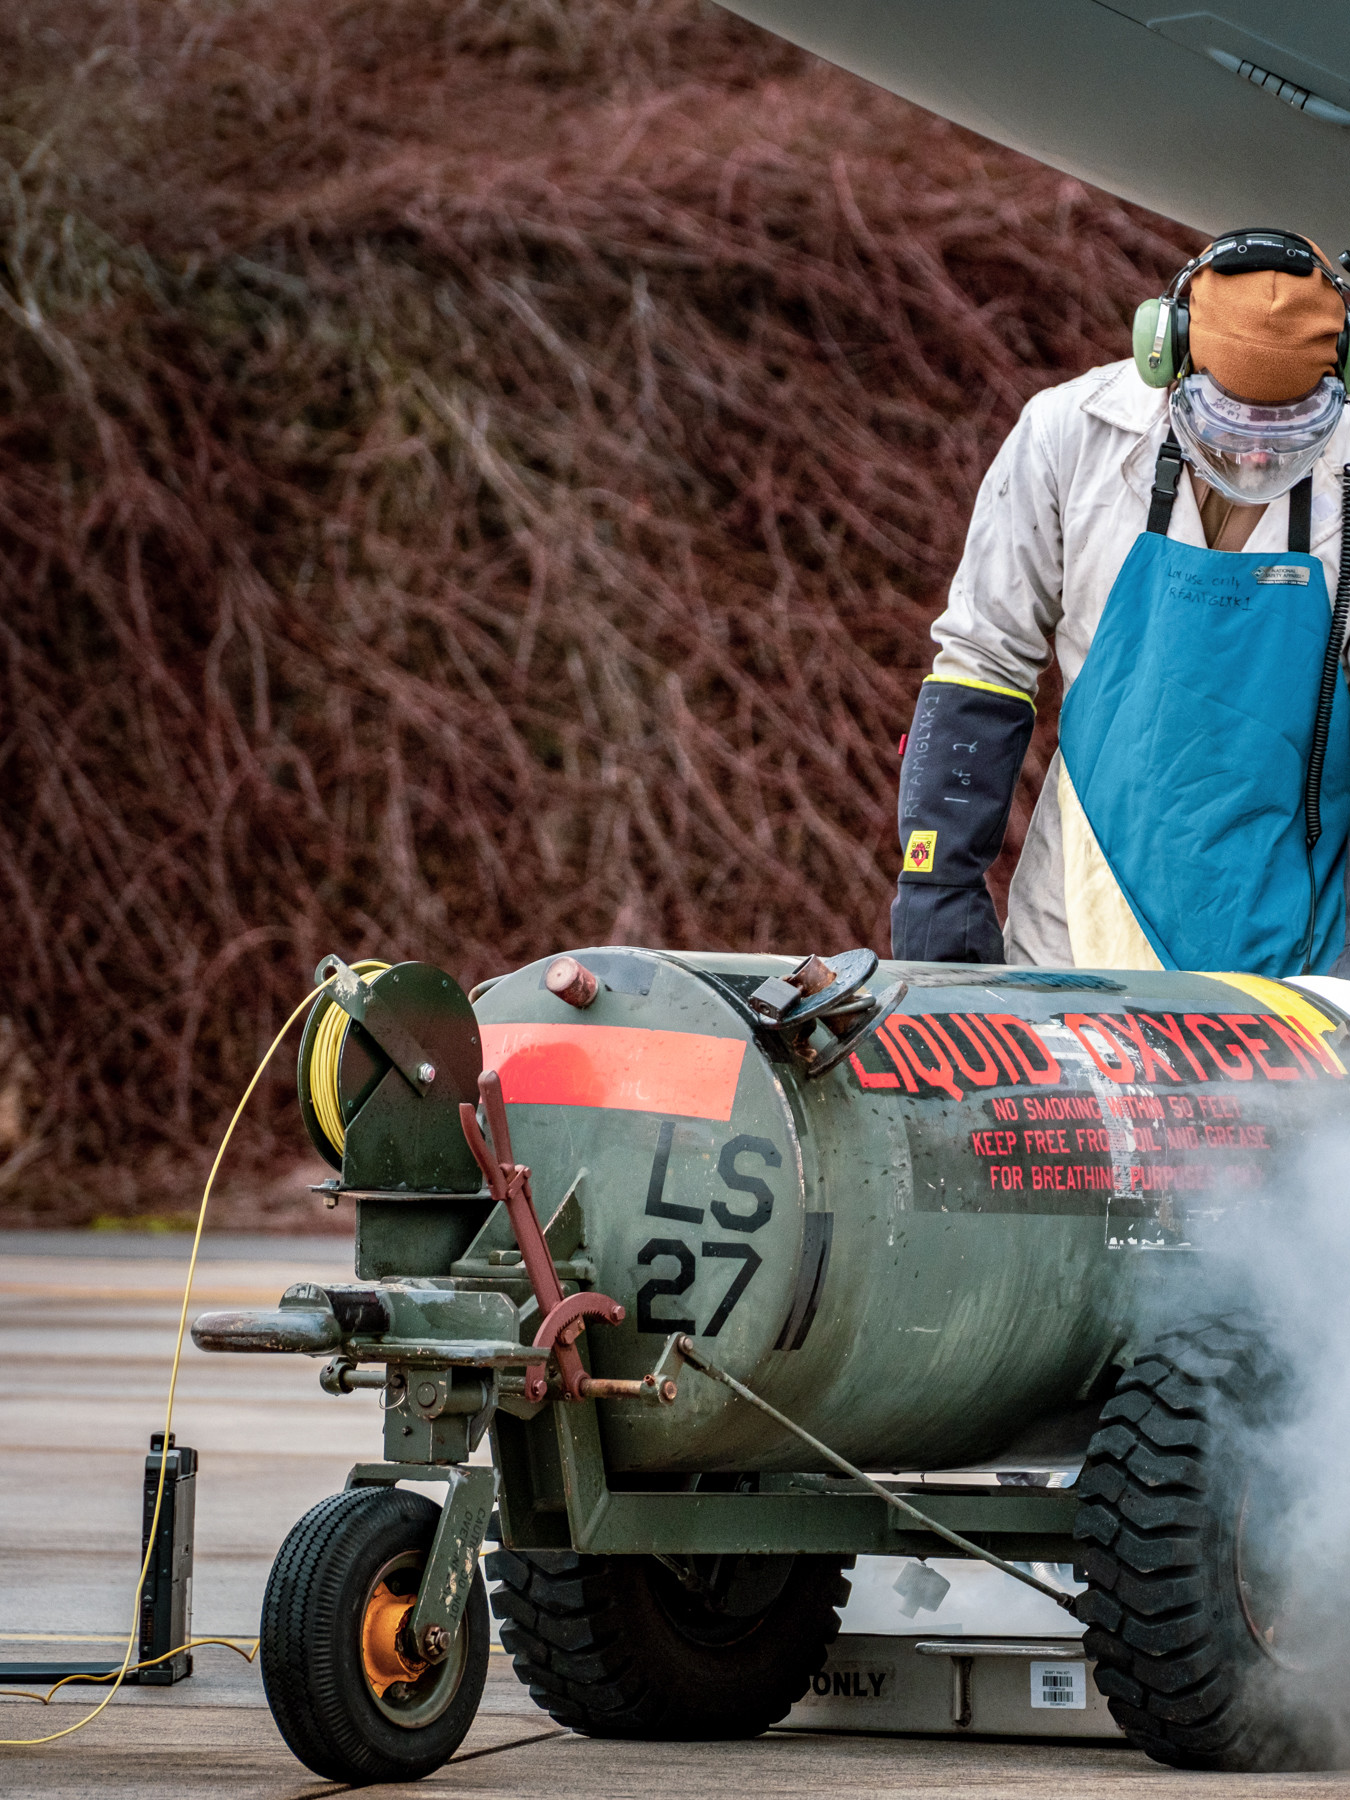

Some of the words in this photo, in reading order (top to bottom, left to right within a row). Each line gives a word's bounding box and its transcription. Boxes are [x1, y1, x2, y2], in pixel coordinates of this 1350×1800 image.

[904, 693, 941, 818] RFAMGLXK1
[849, 1013, 1062, 1103] LIQUID
[1064, 1013, 1348, 1084] OXYGEN
[992, 1098, 1018, 1121] NO
[1023, 1097, 1102, 1121] SMOKING
[1168, 1095, 1194, 1118] 50
[1197, 1095, 1243, 1118] FEET
[972, 1131, 1017, 1156] KEEP
[1024, 1129, 1070, 1154] FREE
[1076, 1128, 1122, 1152] FRO
[1132, 1127, 1162, 1151] OIL
[1168, 1127, 1200, 1150] AND
[1205, 1125, 1271, 1150] GREASE
[644, 1121, 783, 1234] LS
[990, 1166, 1023, 1190] FOR
[637, 1238, 763, 1337] 27
[469, 1507, 486, 1553] CAUTI
[449, 1594, 462, 1622] NOT
[813, 1672, 887, 1697] ONLY
